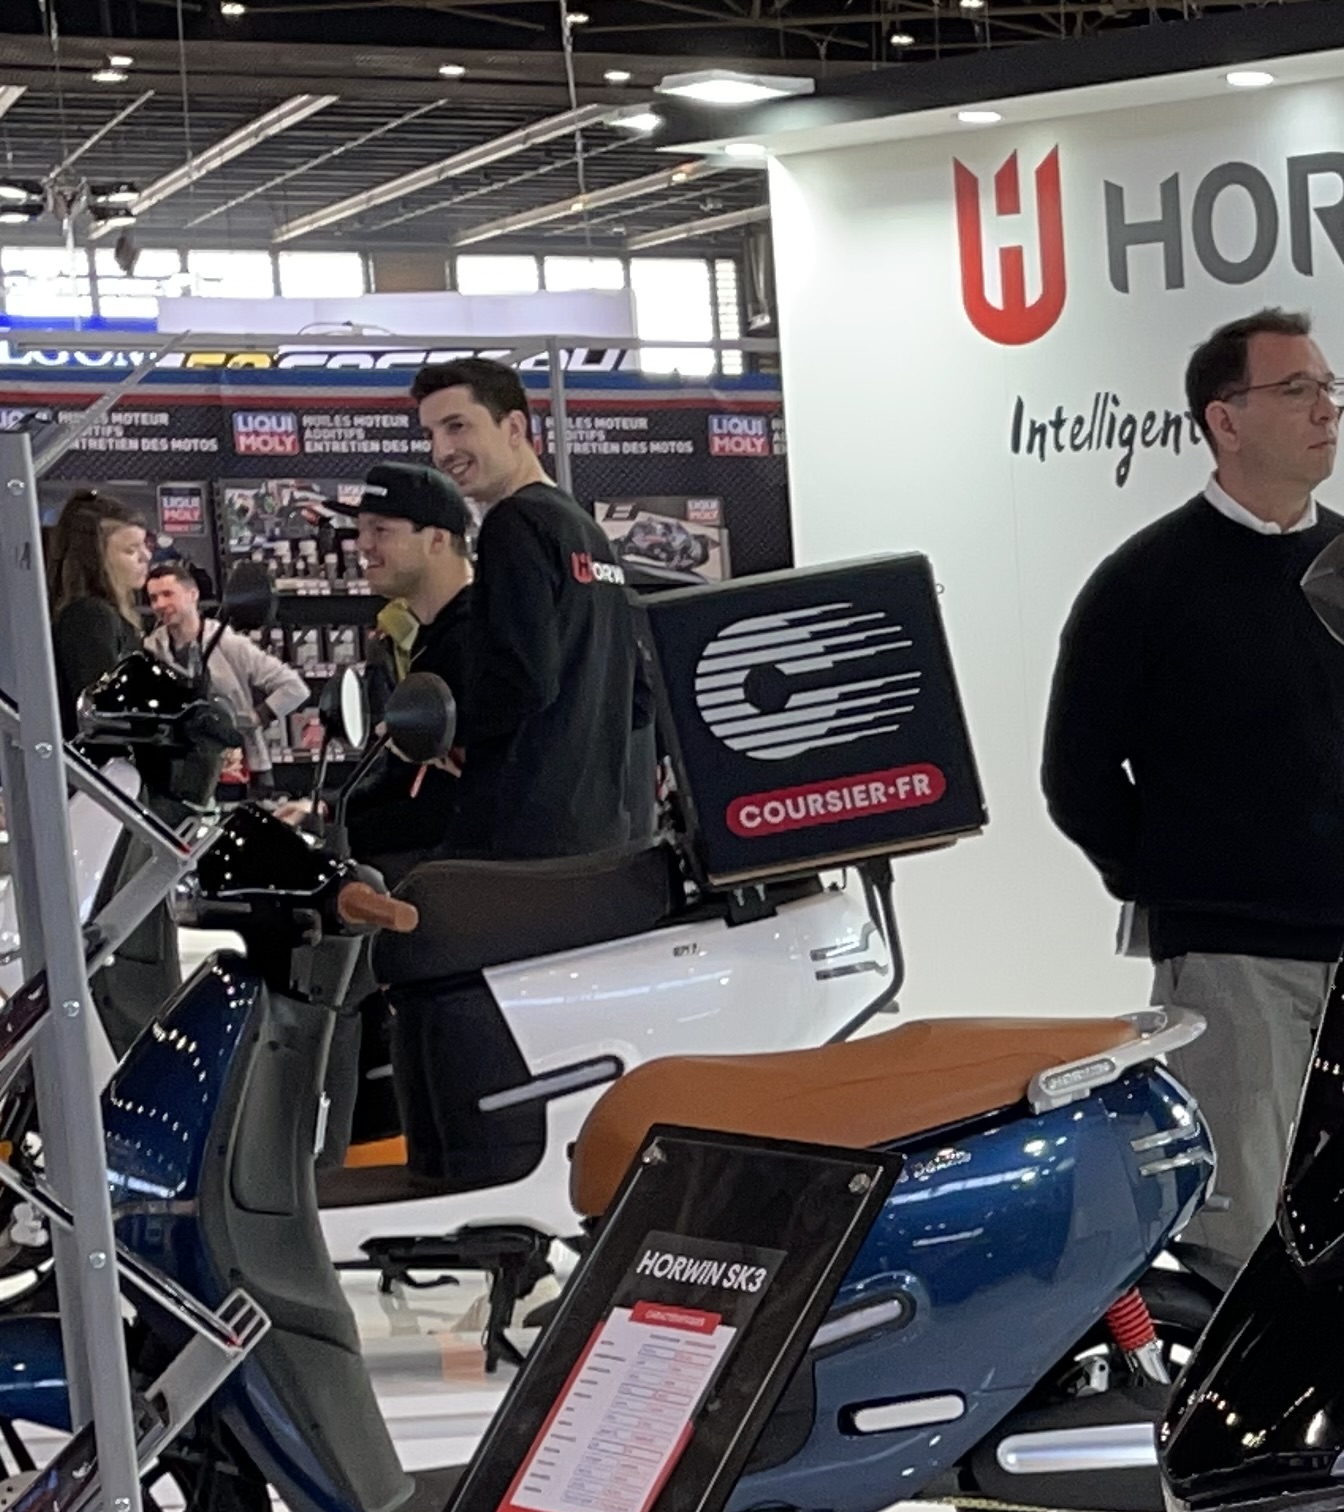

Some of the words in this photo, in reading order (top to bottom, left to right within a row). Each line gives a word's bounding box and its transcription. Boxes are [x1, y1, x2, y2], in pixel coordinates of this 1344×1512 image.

[111, 412, 169, 426] MOTEUR
[236, 414, 294, 433] LIQUI
[353, 414, 409, 428] MOTEUR
[545, 417, 592, 429] HLES
[594, 416, 648, 430] MOTEUR
[713, 417, 765, 435] LIQUI
[141, 437, 168, 451] DES
[170, 437, 218, 451] MOTOS
[238, 433, 297, 452] MOLY
[305, 440, 380, 453] ENTRETIEN
[382, 440, 409, 453] DES
[547, 441, 620, 454] ETRETIEN
[622, 441, 648, 454] DES
[650, 440, 694, 454] MOTOS
[713, 436, 767, 453] MOLY
[636, 1250, 727, 1286] HORWIN
[722, 1262, 767, 1292] SK3
